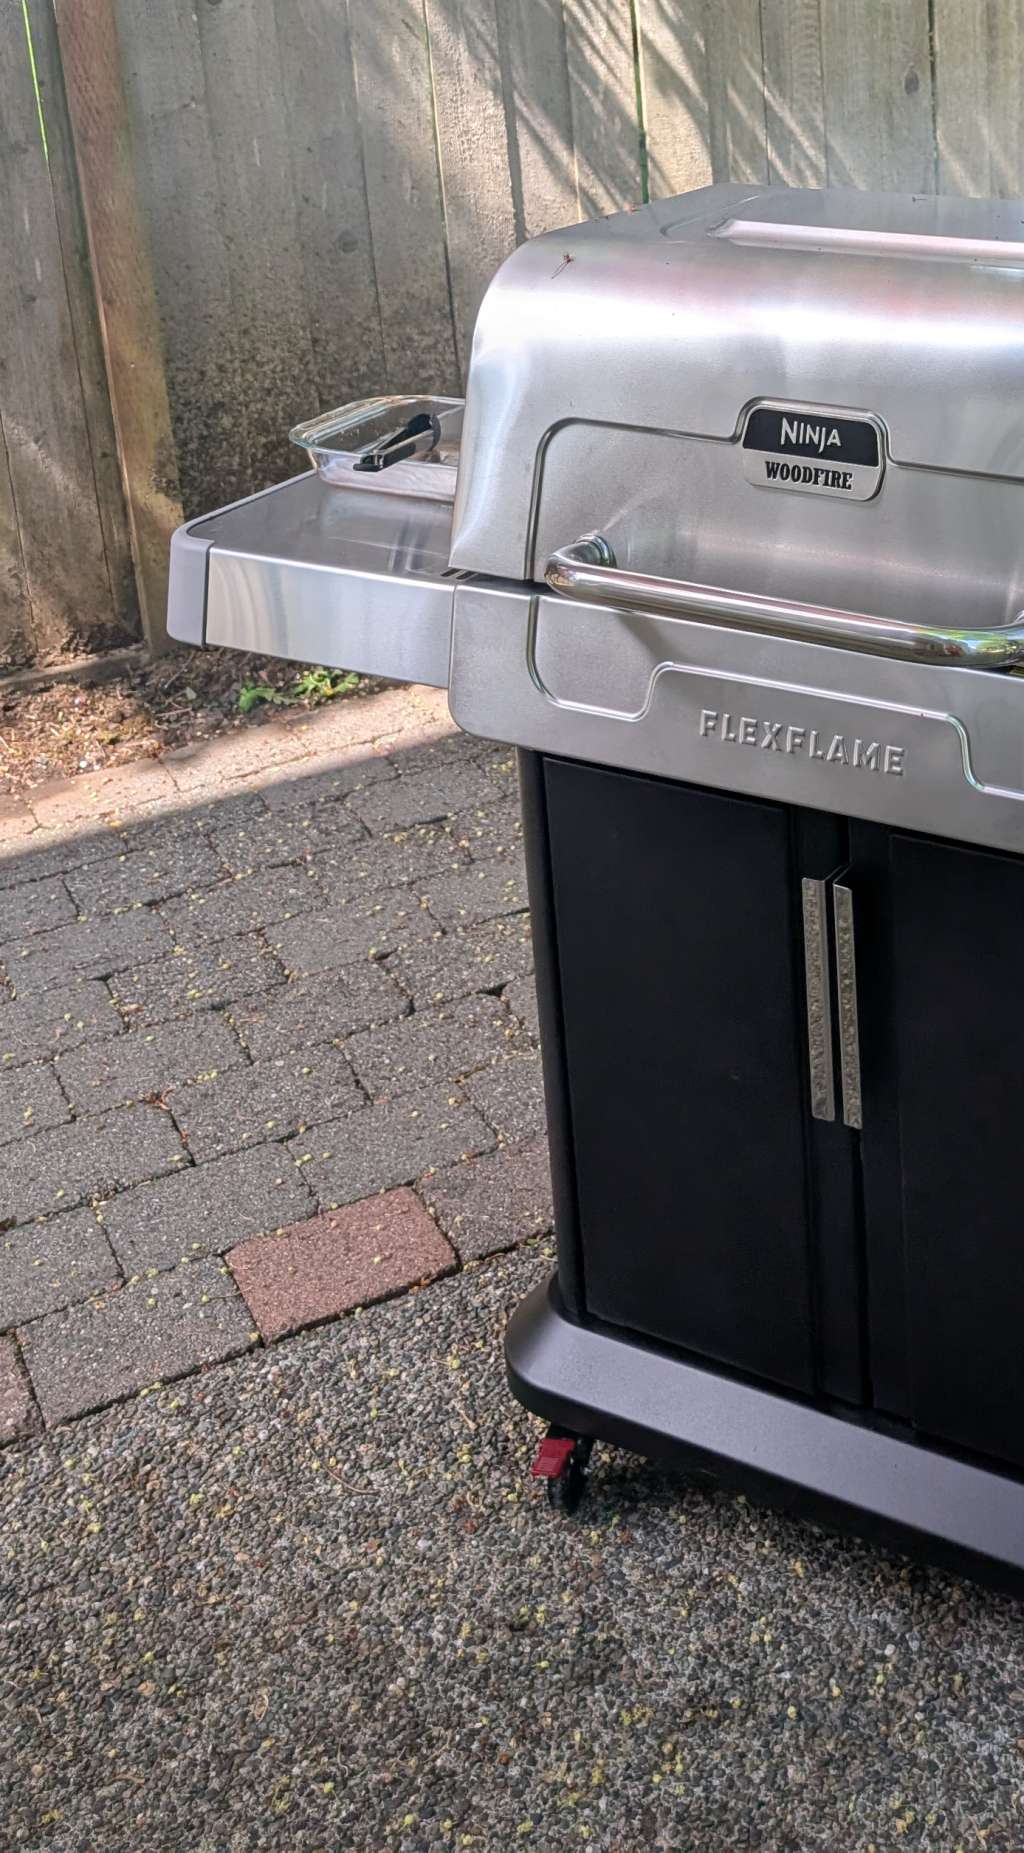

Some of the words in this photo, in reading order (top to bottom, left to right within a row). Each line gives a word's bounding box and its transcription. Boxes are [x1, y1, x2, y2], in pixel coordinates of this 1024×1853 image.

[780, 416, 842, 453] NINJA
[764, 460, 853, 490] WOODFIRE
[700, 708, 904, 776] FLEXFLAME
